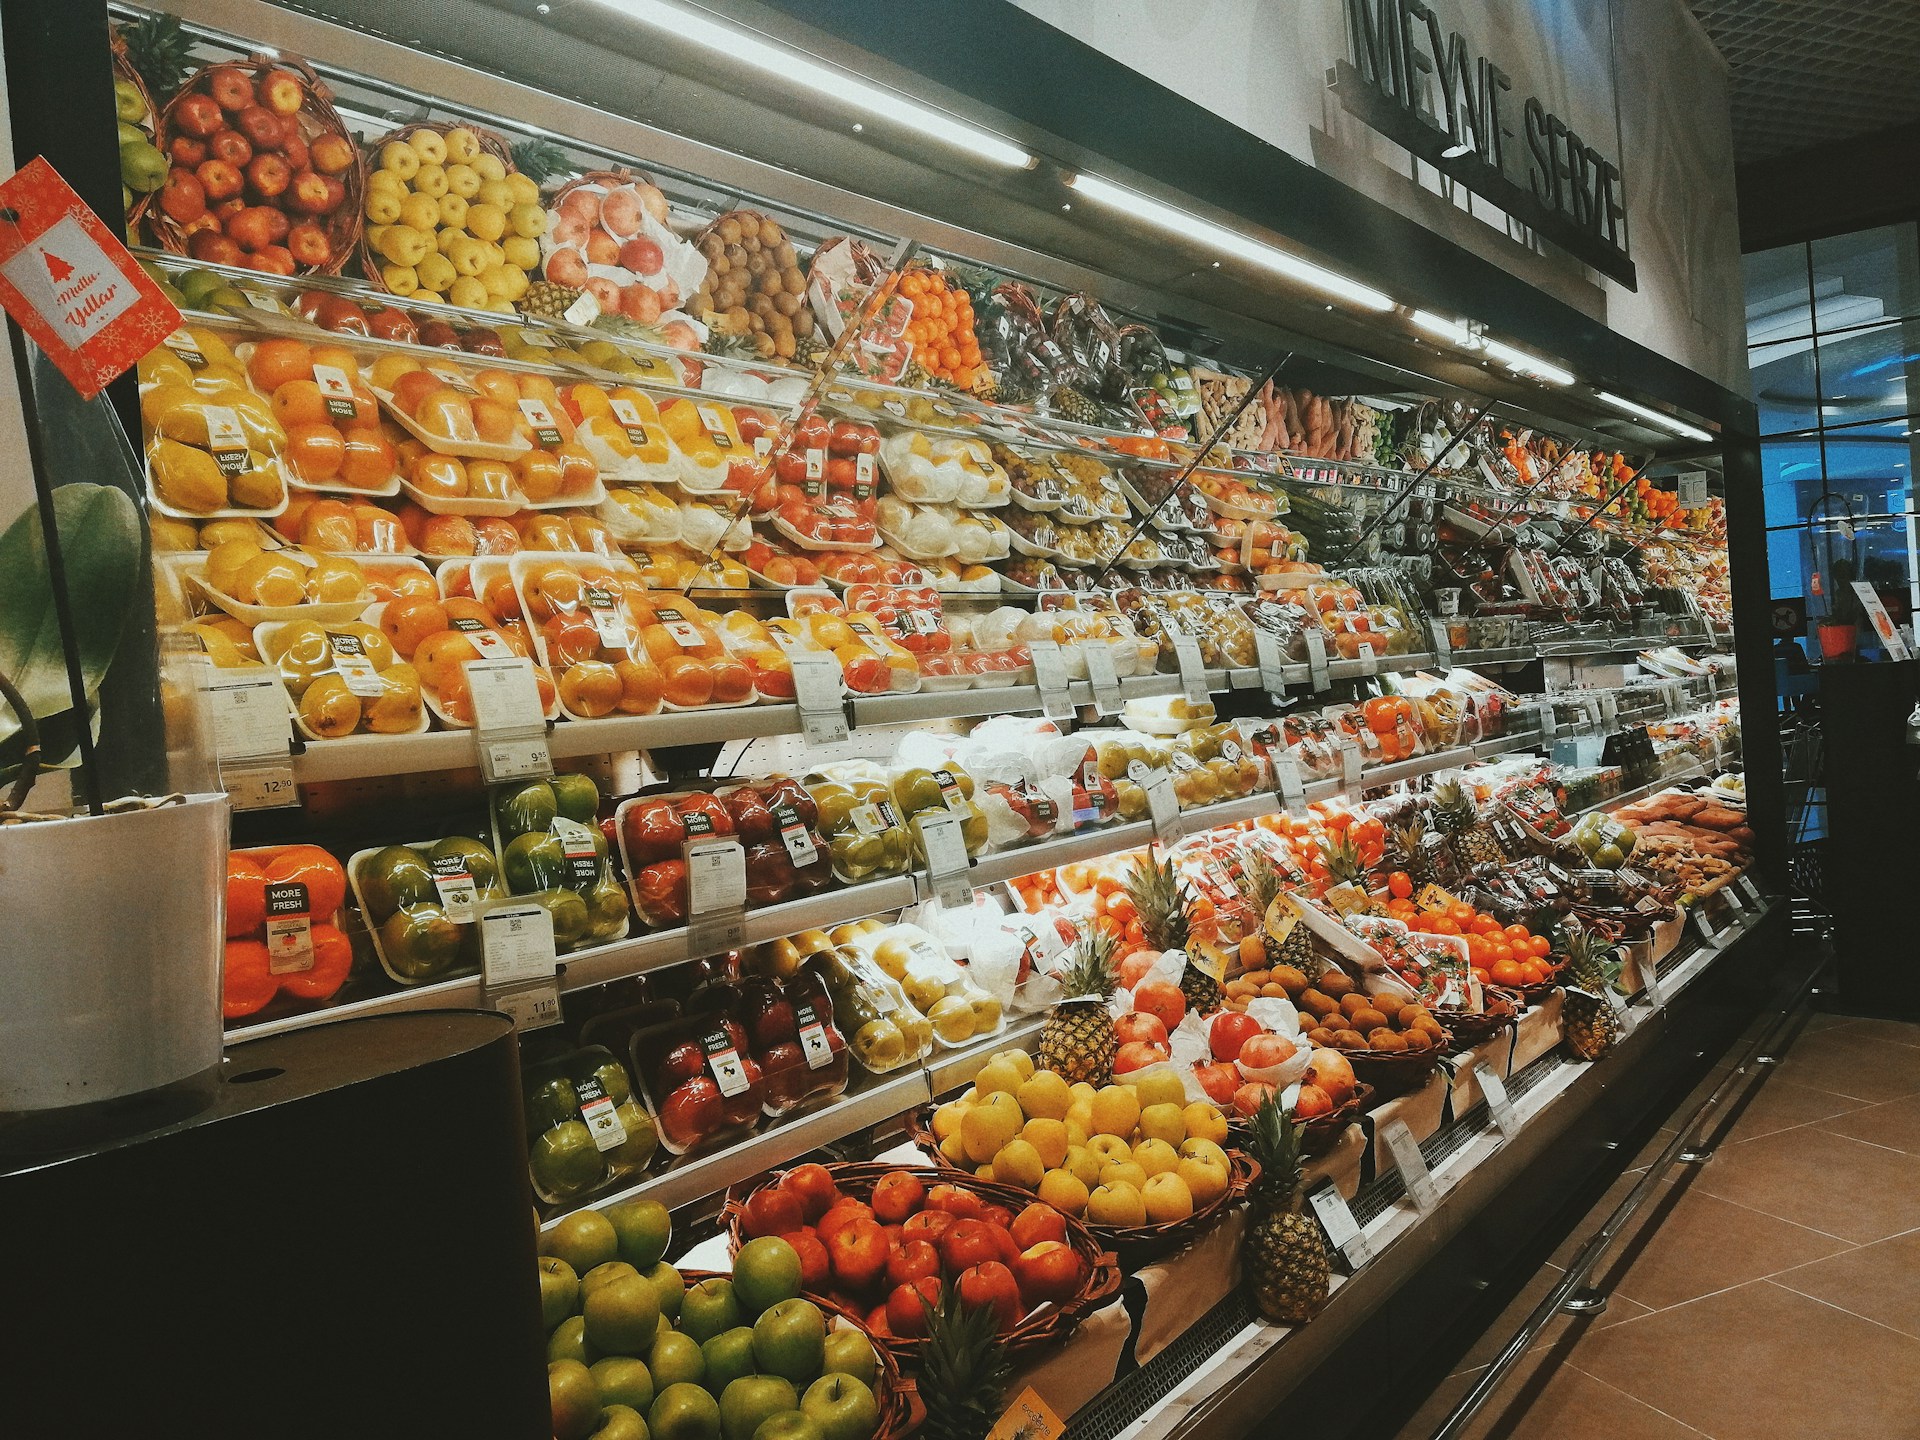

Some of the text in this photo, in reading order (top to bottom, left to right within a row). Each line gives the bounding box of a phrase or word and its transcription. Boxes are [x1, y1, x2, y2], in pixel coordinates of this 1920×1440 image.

[1346, 0, 1628, 254] MEYVE SEBZE
[331, 637, 358, 645] MORE
[335, 644, 360, 652] FRESH
[778, 808, 795, 818] MORE
[687, 815, 707, 824] MORE
[781, 816, 799, 826] FRESH
[690, 824, 709, 832] FRESH
[433, 857, 460, 866] MORE
[573, 860, 594, 868] FRESH
[437, 865, 463, 874] FRESH
[575, 869, 596, 877] MORE
[271, 888, 302, 900] MORE
[272, 900, 303, 911] FRESH
[797, 1006, 813, 1016] MORE
[800, 1014, 816, 1025] FRESH
[704, 1032, 726, 1043] MORE
[708, 1040, 729, 1052] FRESH
[576, 1080, 598, 1092] MORE
[581, 1089, 602, 1102] FRESH
